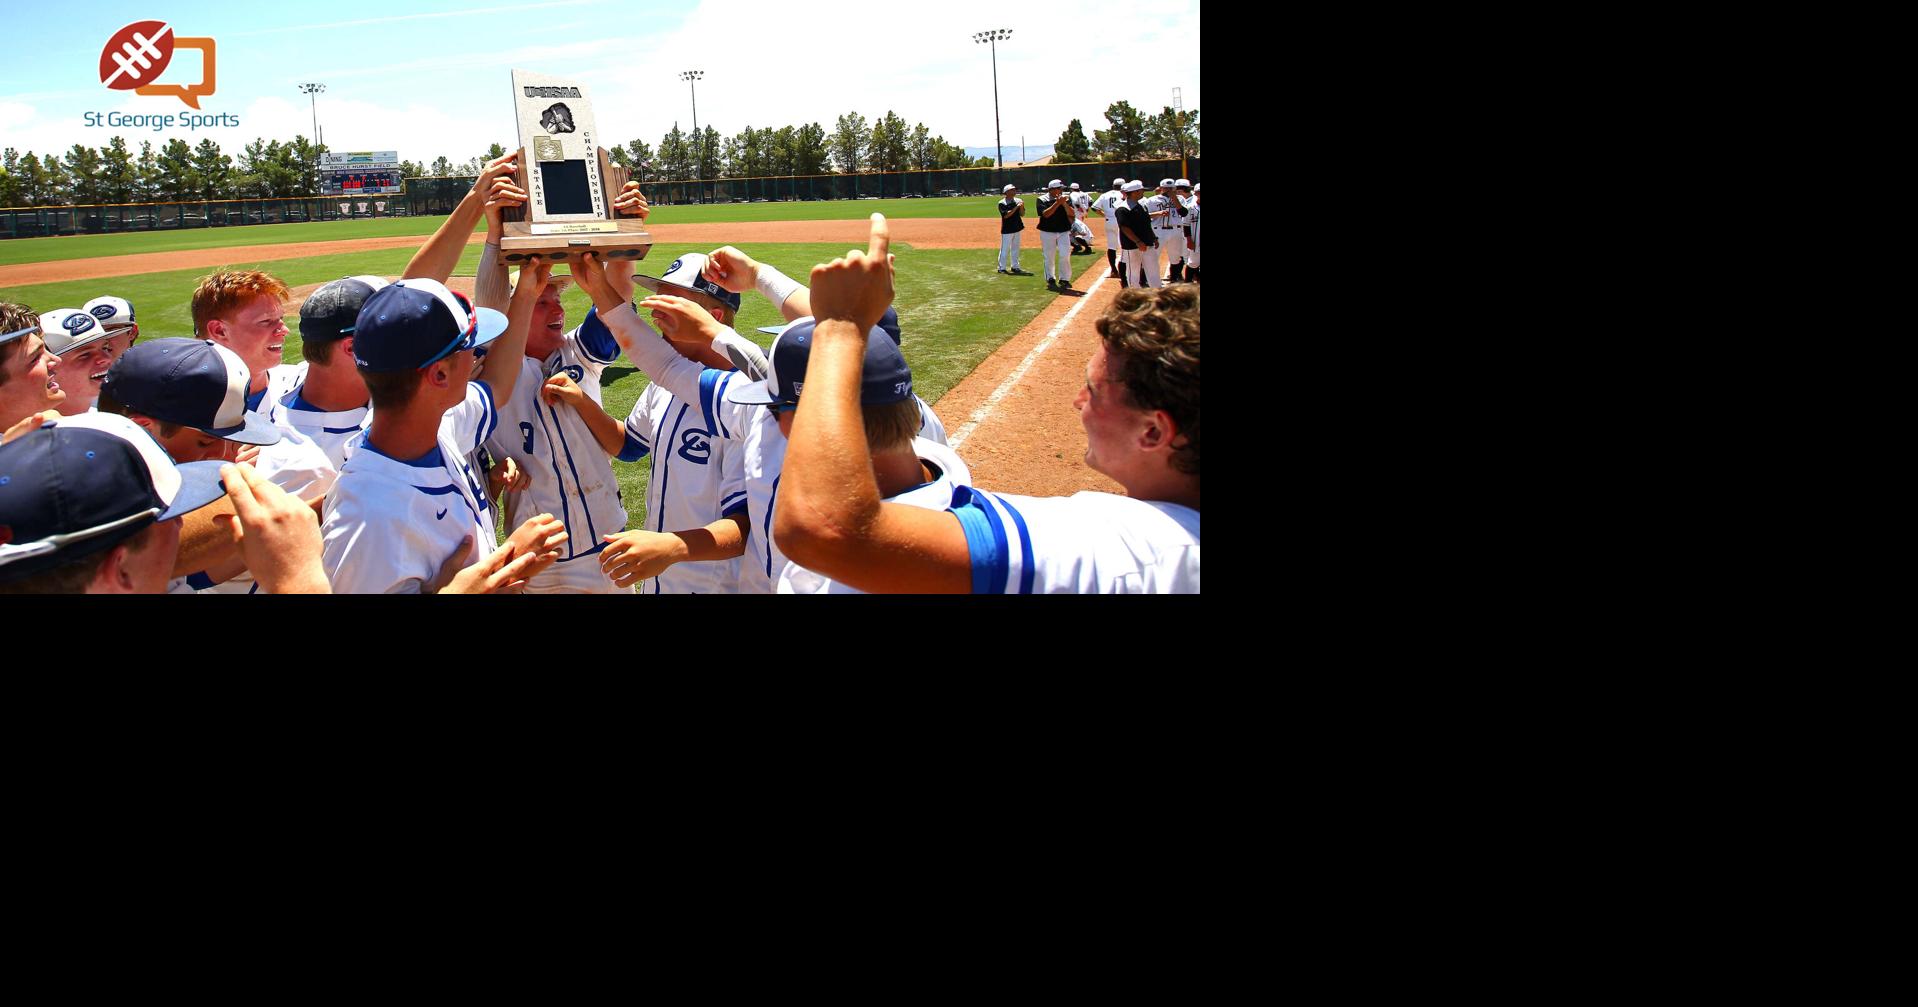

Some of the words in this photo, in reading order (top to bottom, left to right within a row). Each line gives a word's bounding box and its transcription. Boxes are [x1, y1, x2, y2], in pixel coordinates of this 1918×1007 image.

[533, 169, 543, 206] STATE
[583, 131, 603, 218] CHAMPIONSHIP
[518, 421, 534, 454] 9
